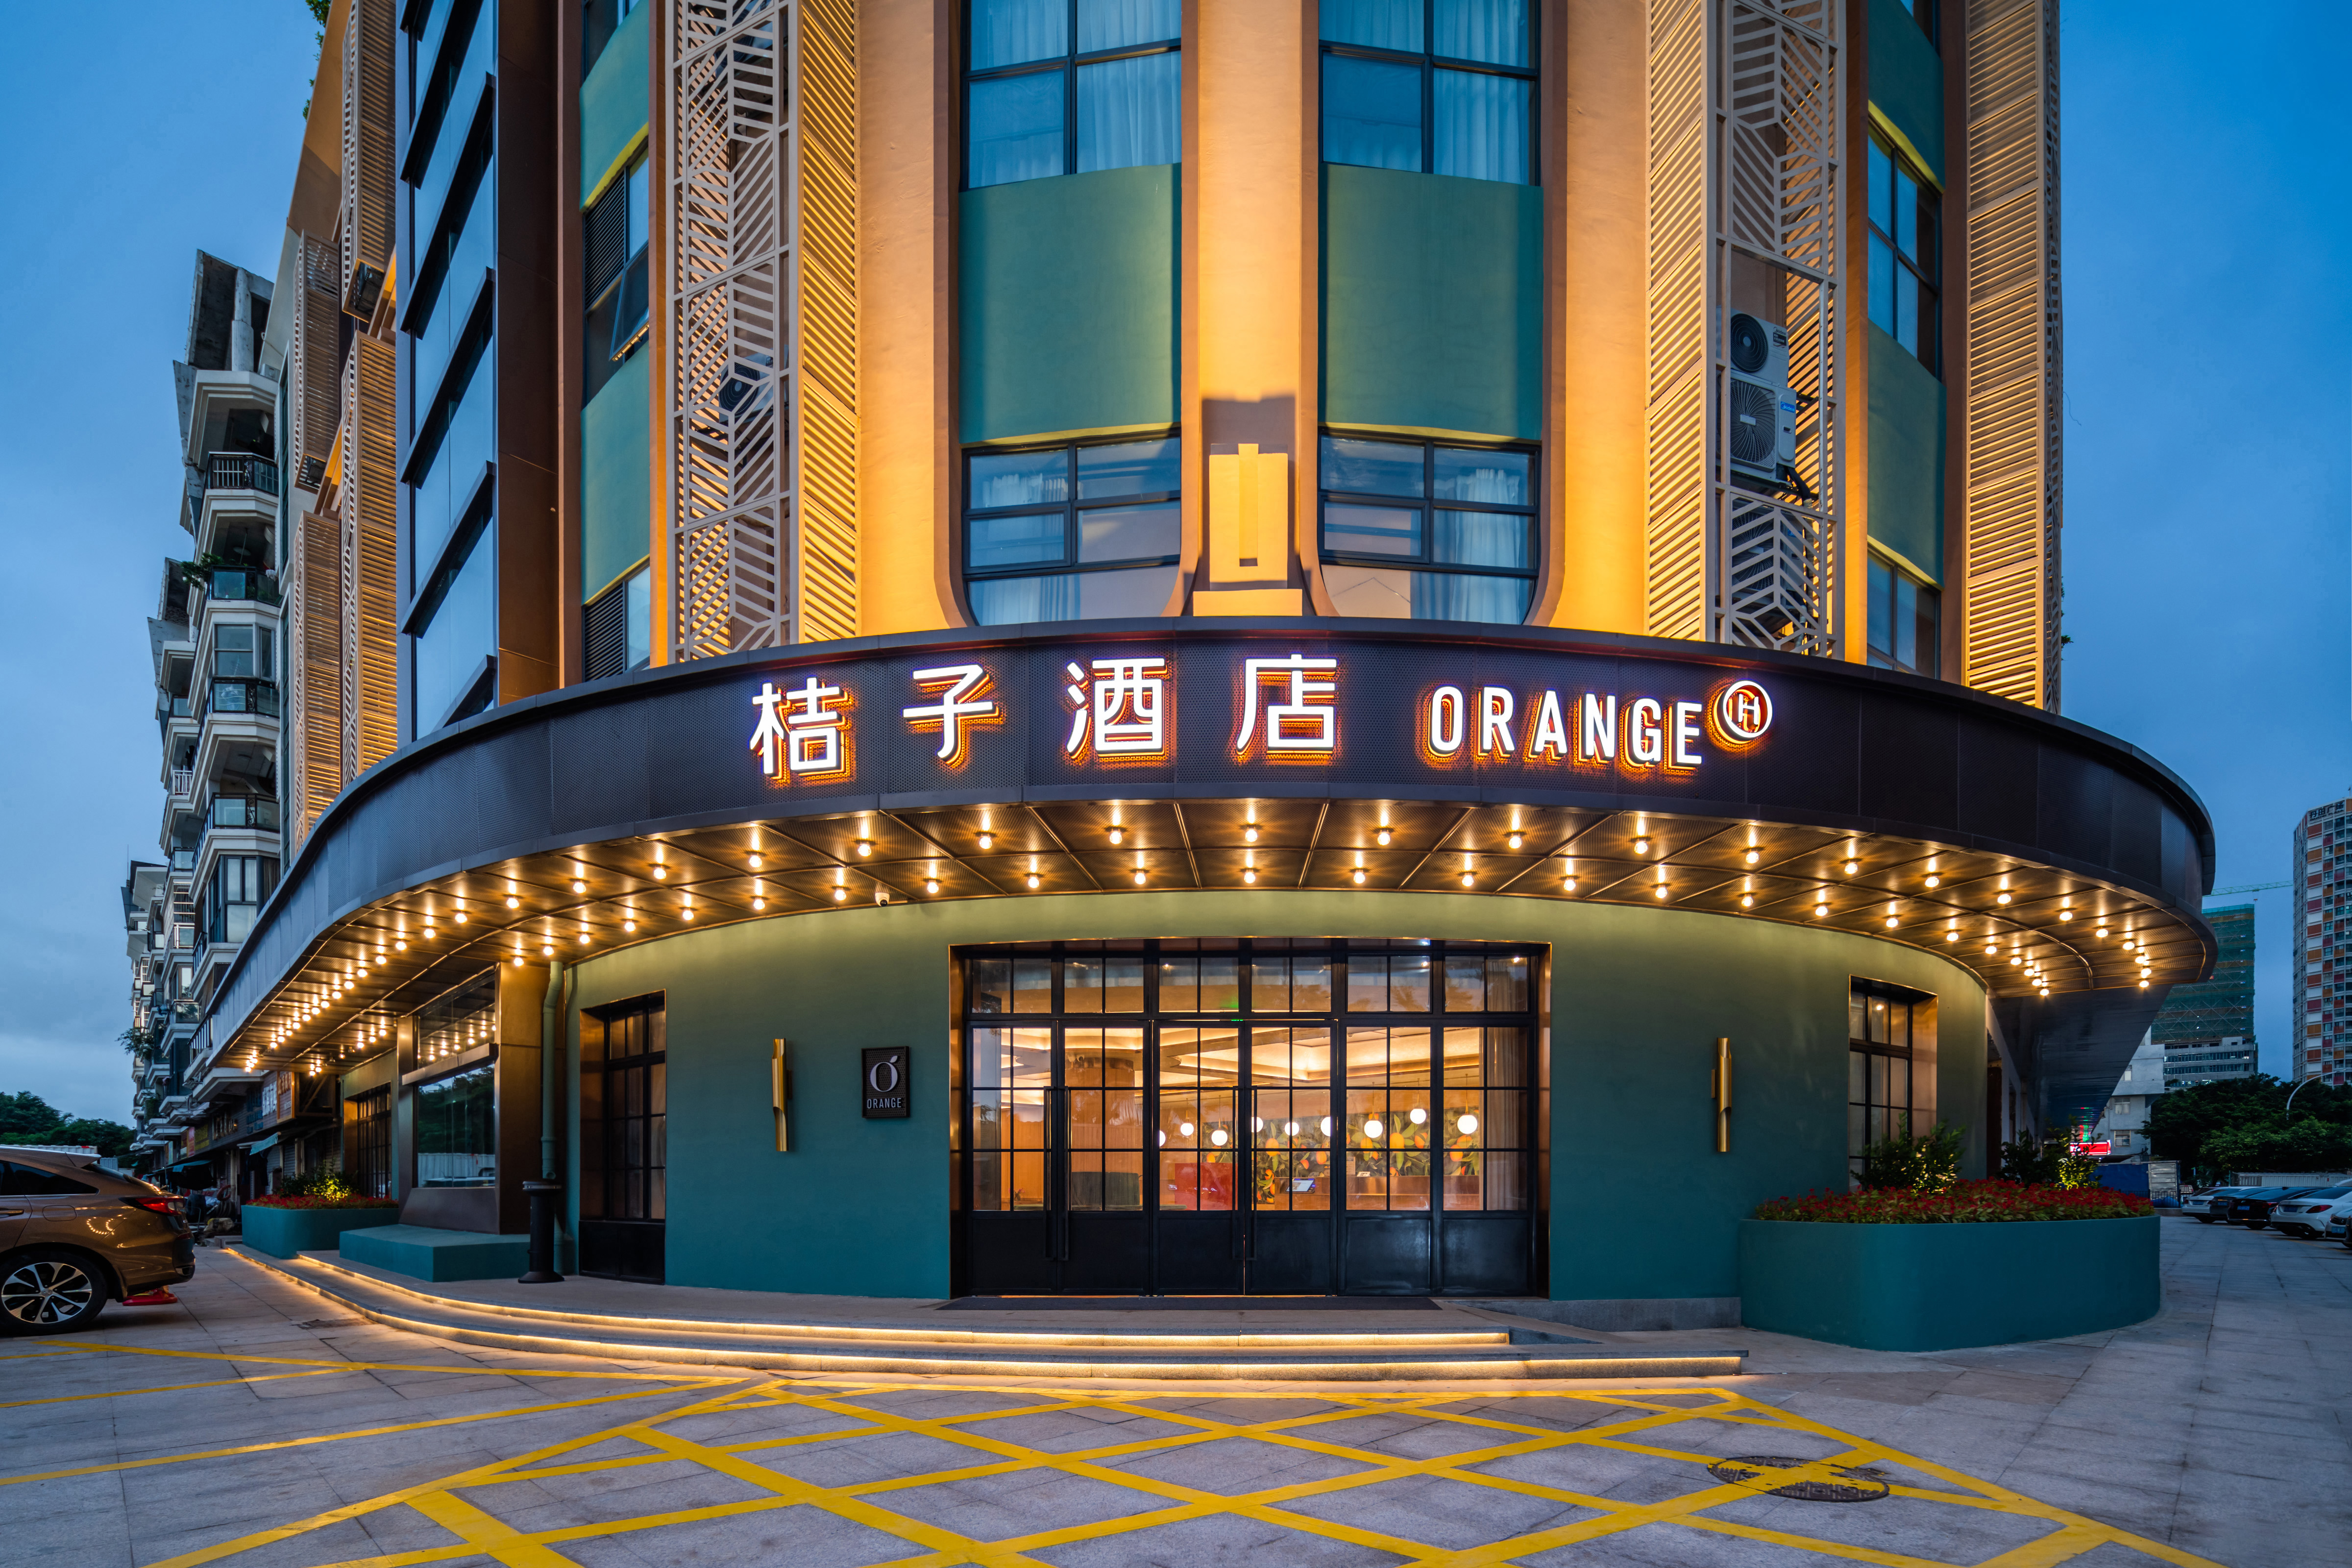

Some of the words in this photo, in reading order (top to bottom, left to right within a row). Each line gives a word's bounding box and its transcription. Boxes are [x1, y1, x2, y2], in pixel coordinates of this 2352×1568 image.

[1781, 403, 1794, 412] Midea
[749, 653, 1337, 775] 桔子酒店
[1431, 686, 1702, 764] ORANGE
[2309, 802, 2344, 819] 丹田广场
[867, 1098, 902, 1109] ORANGE
